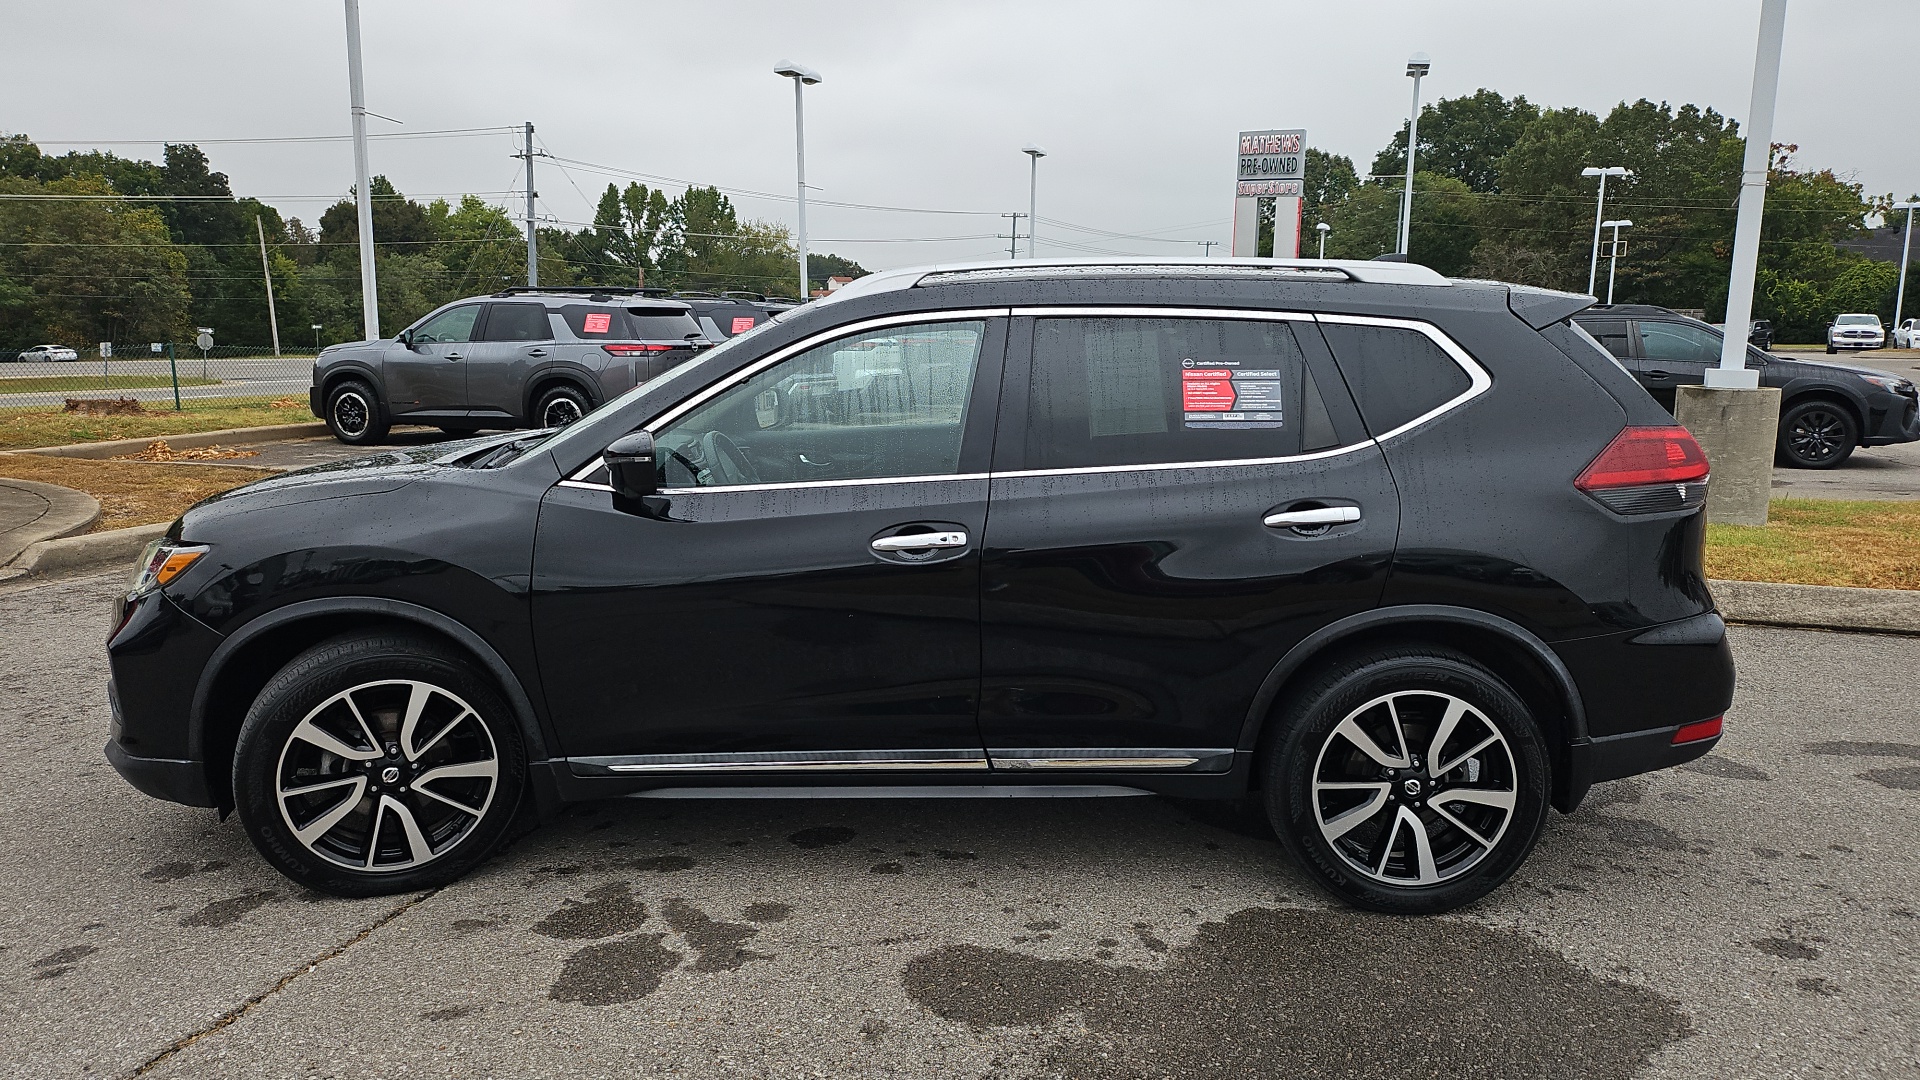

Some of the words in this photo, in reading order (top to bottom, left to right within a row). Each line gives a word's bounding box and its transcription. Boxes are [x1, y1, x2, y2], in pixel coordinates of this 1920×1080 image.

[1240, 133, 1300, 155] MATHEWS
[1240, 157, 1298, 175] PRE-OWNED
[261, 825, 311, 876] KUMHO
[1302, 836, 1347, 887] KUMHO
